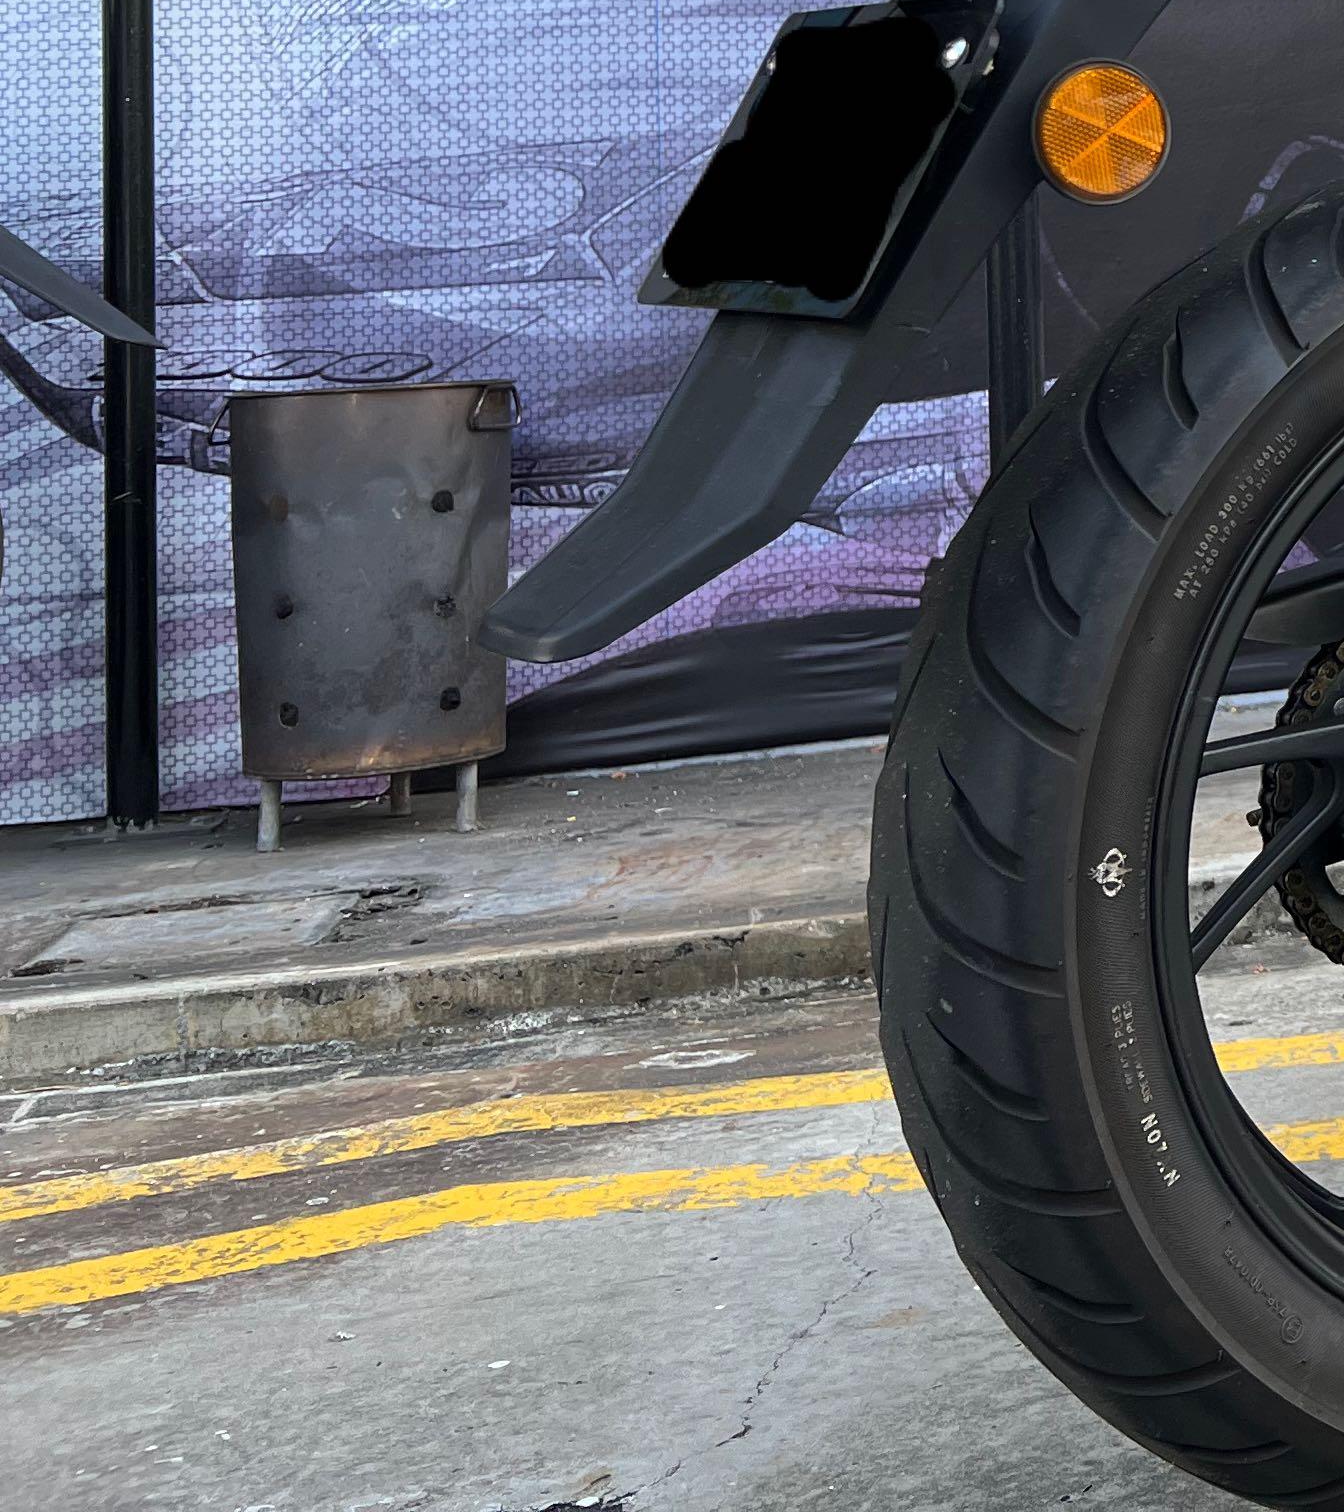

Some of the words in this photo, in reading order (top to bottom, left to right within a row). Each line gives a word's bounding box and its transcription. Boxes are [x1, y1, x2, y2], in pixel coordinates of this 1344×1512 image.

[1273, 437, 1297, 466] COLD
[1195, 524, 1218, 557] LOAD
[1218, 494, 1238, 519] 300
